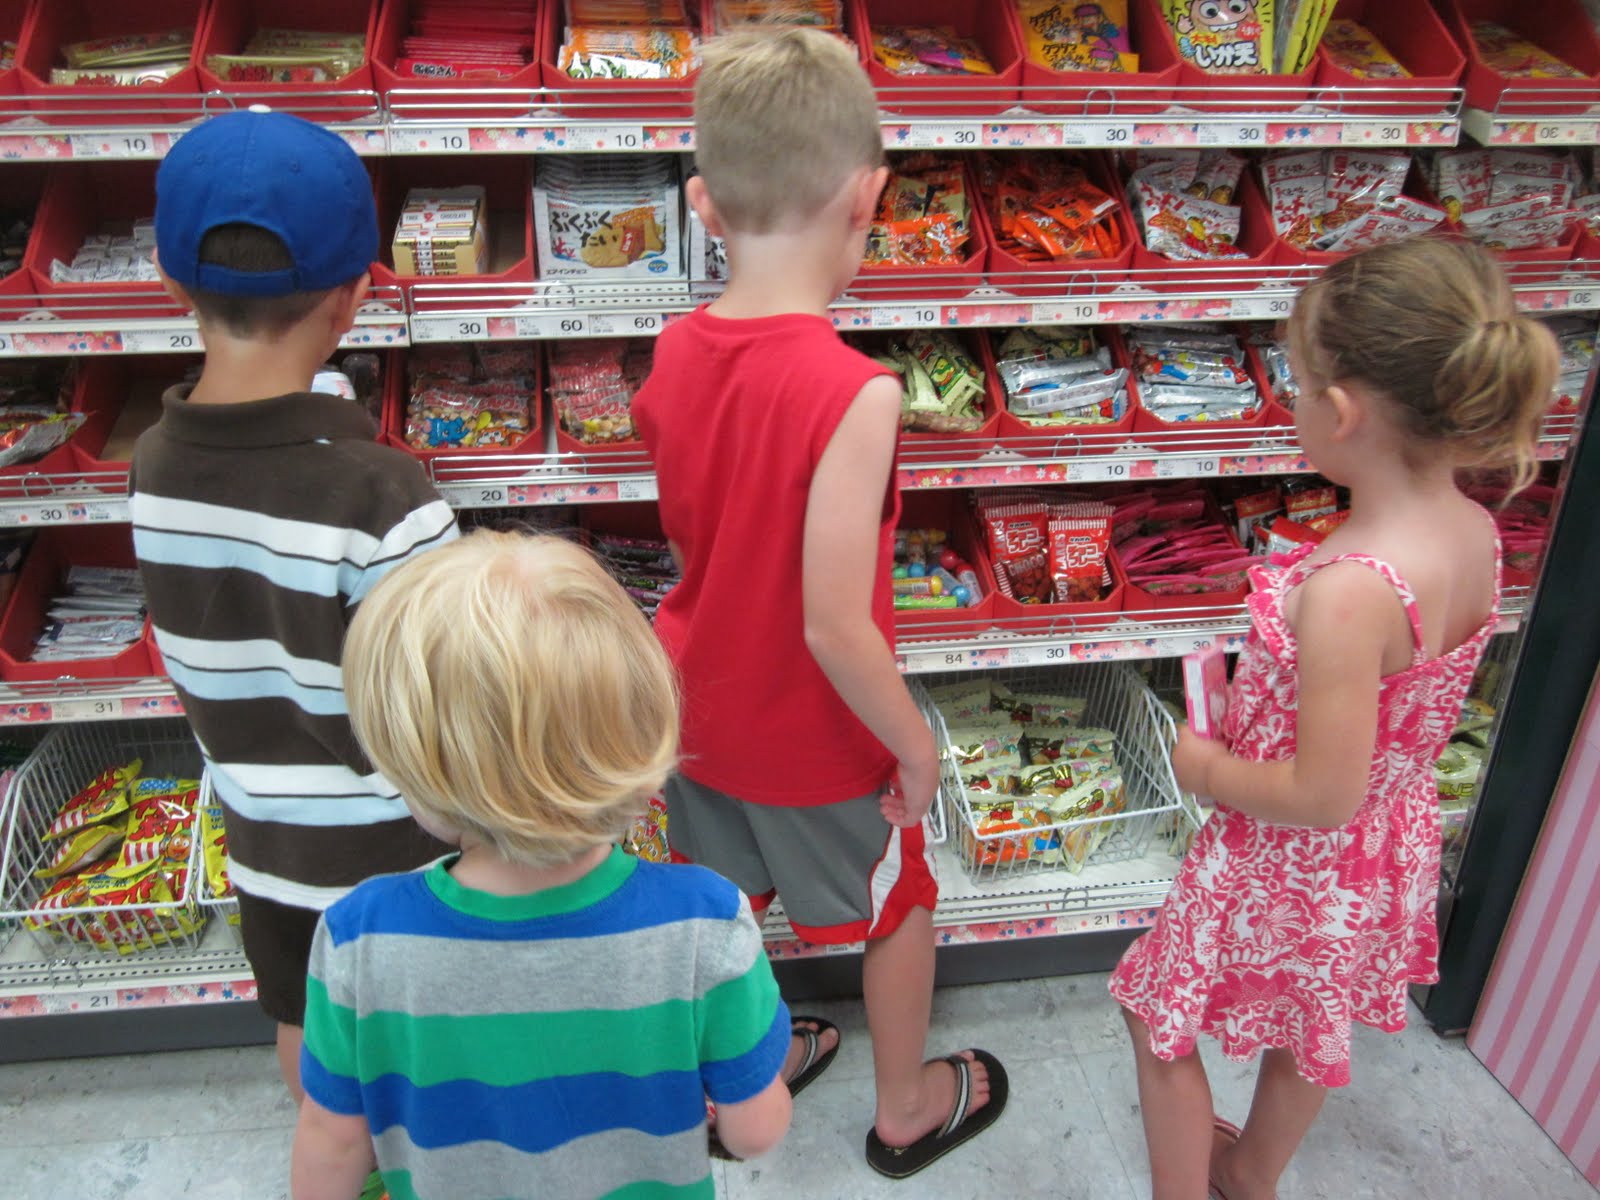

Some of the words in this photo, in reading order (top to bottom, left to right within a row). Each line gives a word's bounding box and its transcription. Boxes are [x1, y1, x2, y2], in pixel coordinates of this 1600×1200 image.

[1194, 40, 1259, 69] いか天
[955, 131, 975, 143] 30
[1106, 129, 1127, 141] 30
[1239, 128, 1259, 140] 30
[1381, 127, 1400, 140] 30
[123, 138, 146, 152] 10
[441, 136, 462, 149] 10
[616, 134, 636, 147] 10
[549, 210, 613, 233] ぷくぷく
[1074, 306, 1092, 317] 10
[1269, 301, 1288, 312] 30
[634, 316, 655, 328] 60
[915, 310, 934, 322] 10
[459, 323, 481, 335] 30
[561, 320, 582, 331] 60
[170, 335, 192, 347] 20
[1106, 465, 1124, 475] 10
[1197, 461, 1214, 471] 10
[481, 490, 502, 501] 20
[41, 509, 62, 520] 30
[945, 654, 963, 664] 84
[1046, 648, 1064, 658] 30
[95, 702, 113, 712] 31
[1094, 915, 1110, 925] 21
[90, 995, 109, 1007] 21
